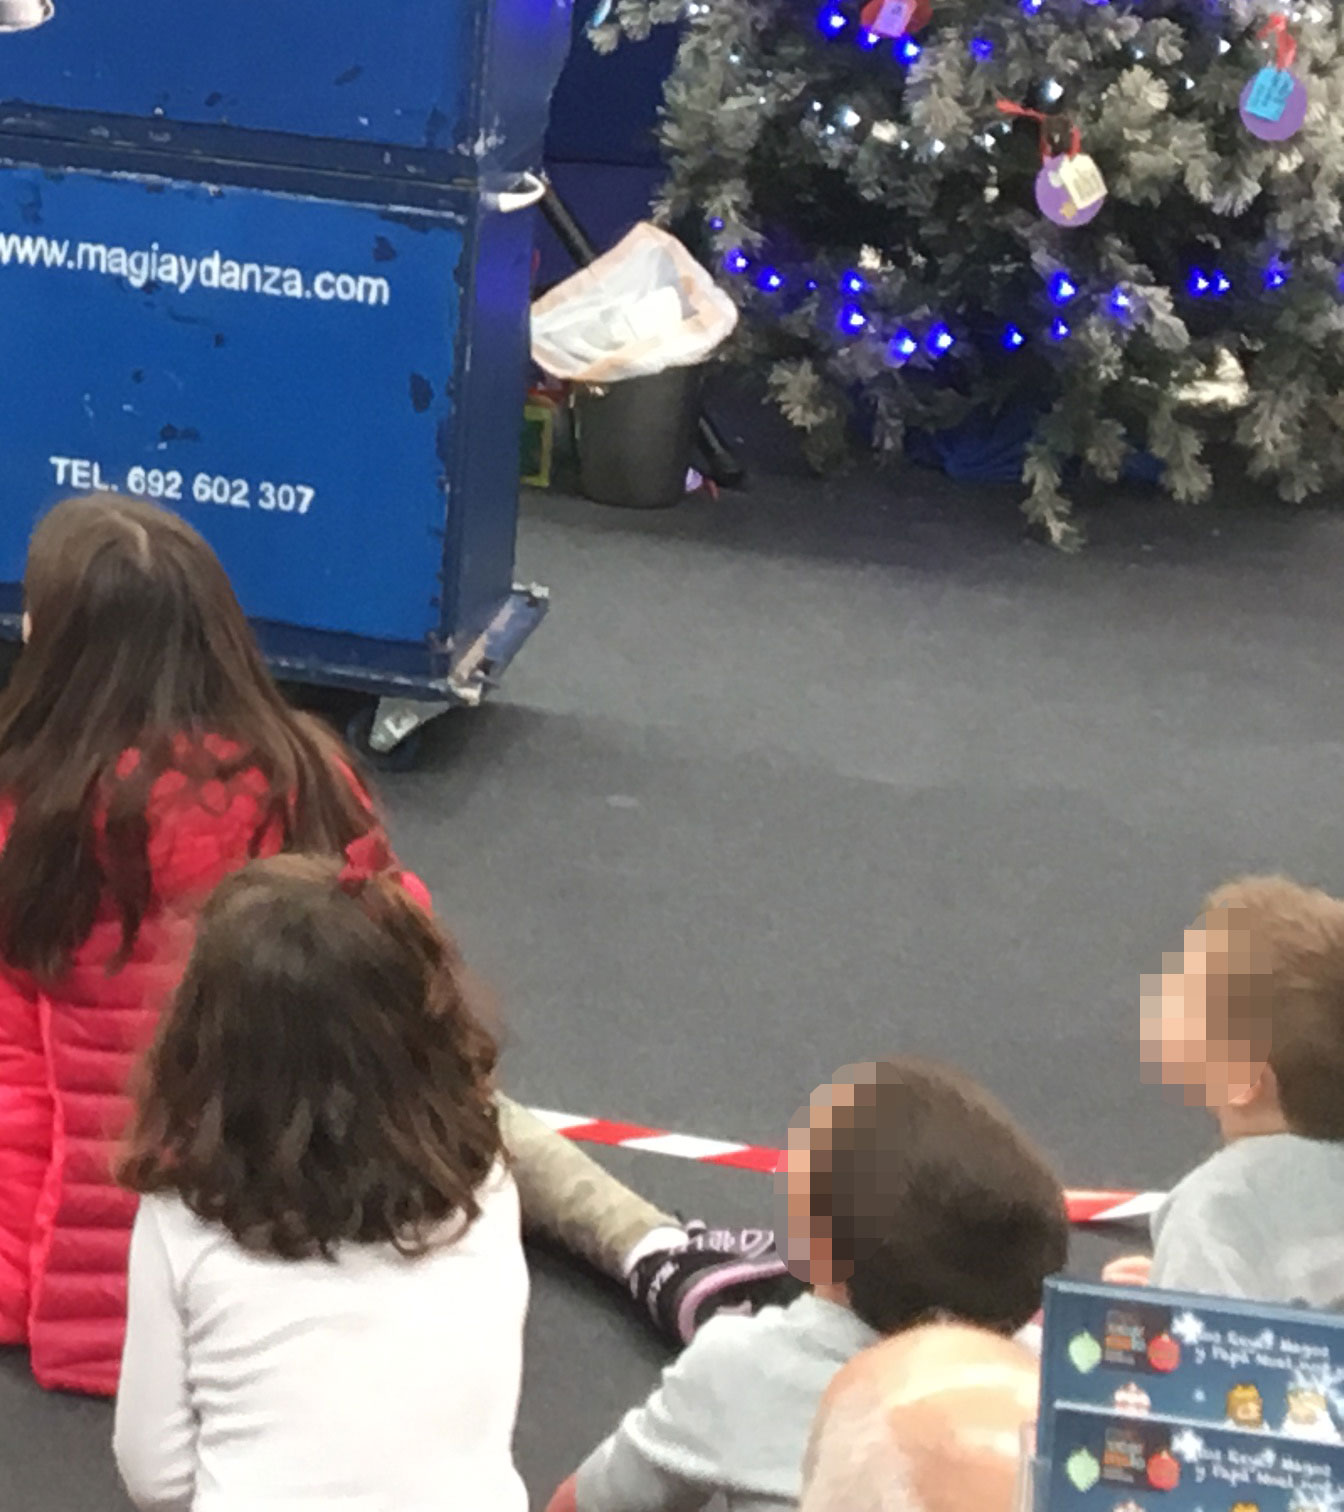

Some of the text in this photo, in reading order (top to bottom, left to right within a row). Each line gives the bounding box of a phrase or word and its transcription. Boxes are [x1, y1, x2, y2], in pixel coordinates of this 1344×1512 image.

[49, 455, 316, 514] TEL. 692 602 307
